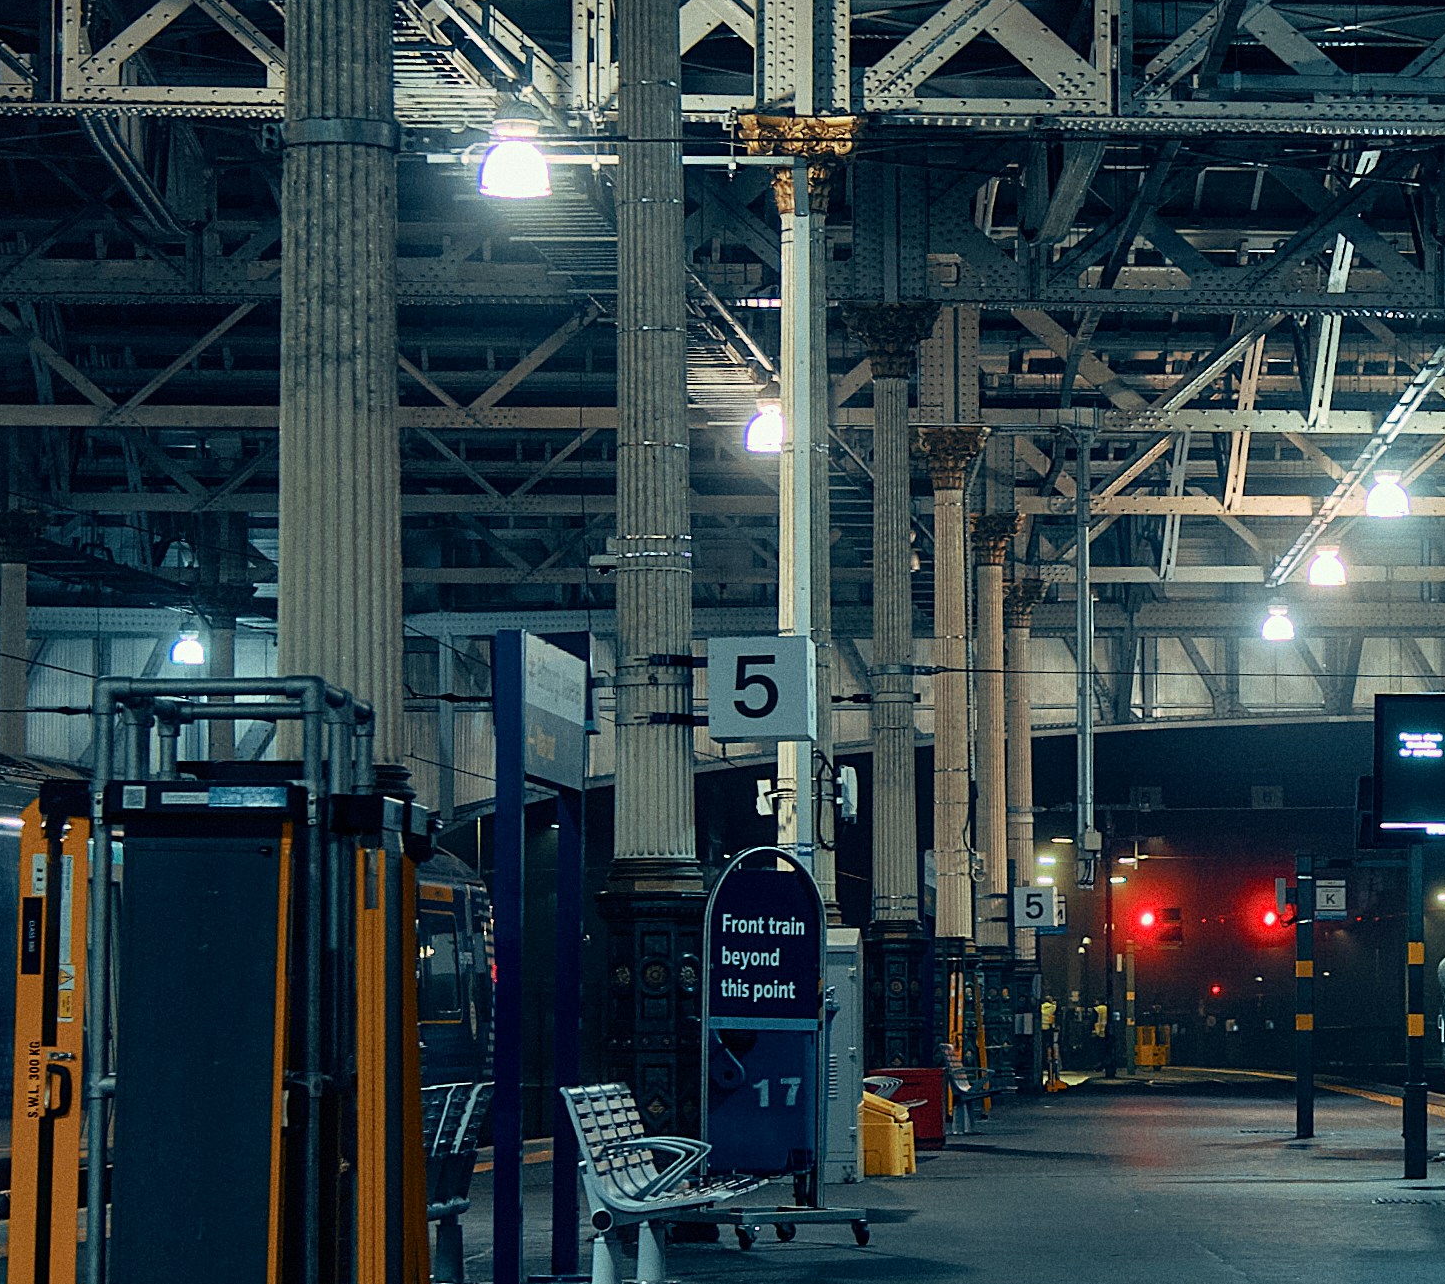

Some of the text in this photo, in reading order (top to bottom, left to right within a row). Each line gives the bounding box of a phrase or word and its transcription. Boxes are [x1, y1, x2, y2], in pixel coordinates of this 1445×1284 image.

[734, 655, 778, 718] 5
[1025, 894, 1043, 919] 5
[1326, 893, 1335, 904] K
[722, 914, 805, 936] Front train
[721, 946, 780, 970] beyond
[720, 978, 796, 1002] this point
[28, 1041, 40, 1118] S.W.L. 300 KG
[753, 1077, 802, 1108] 17
